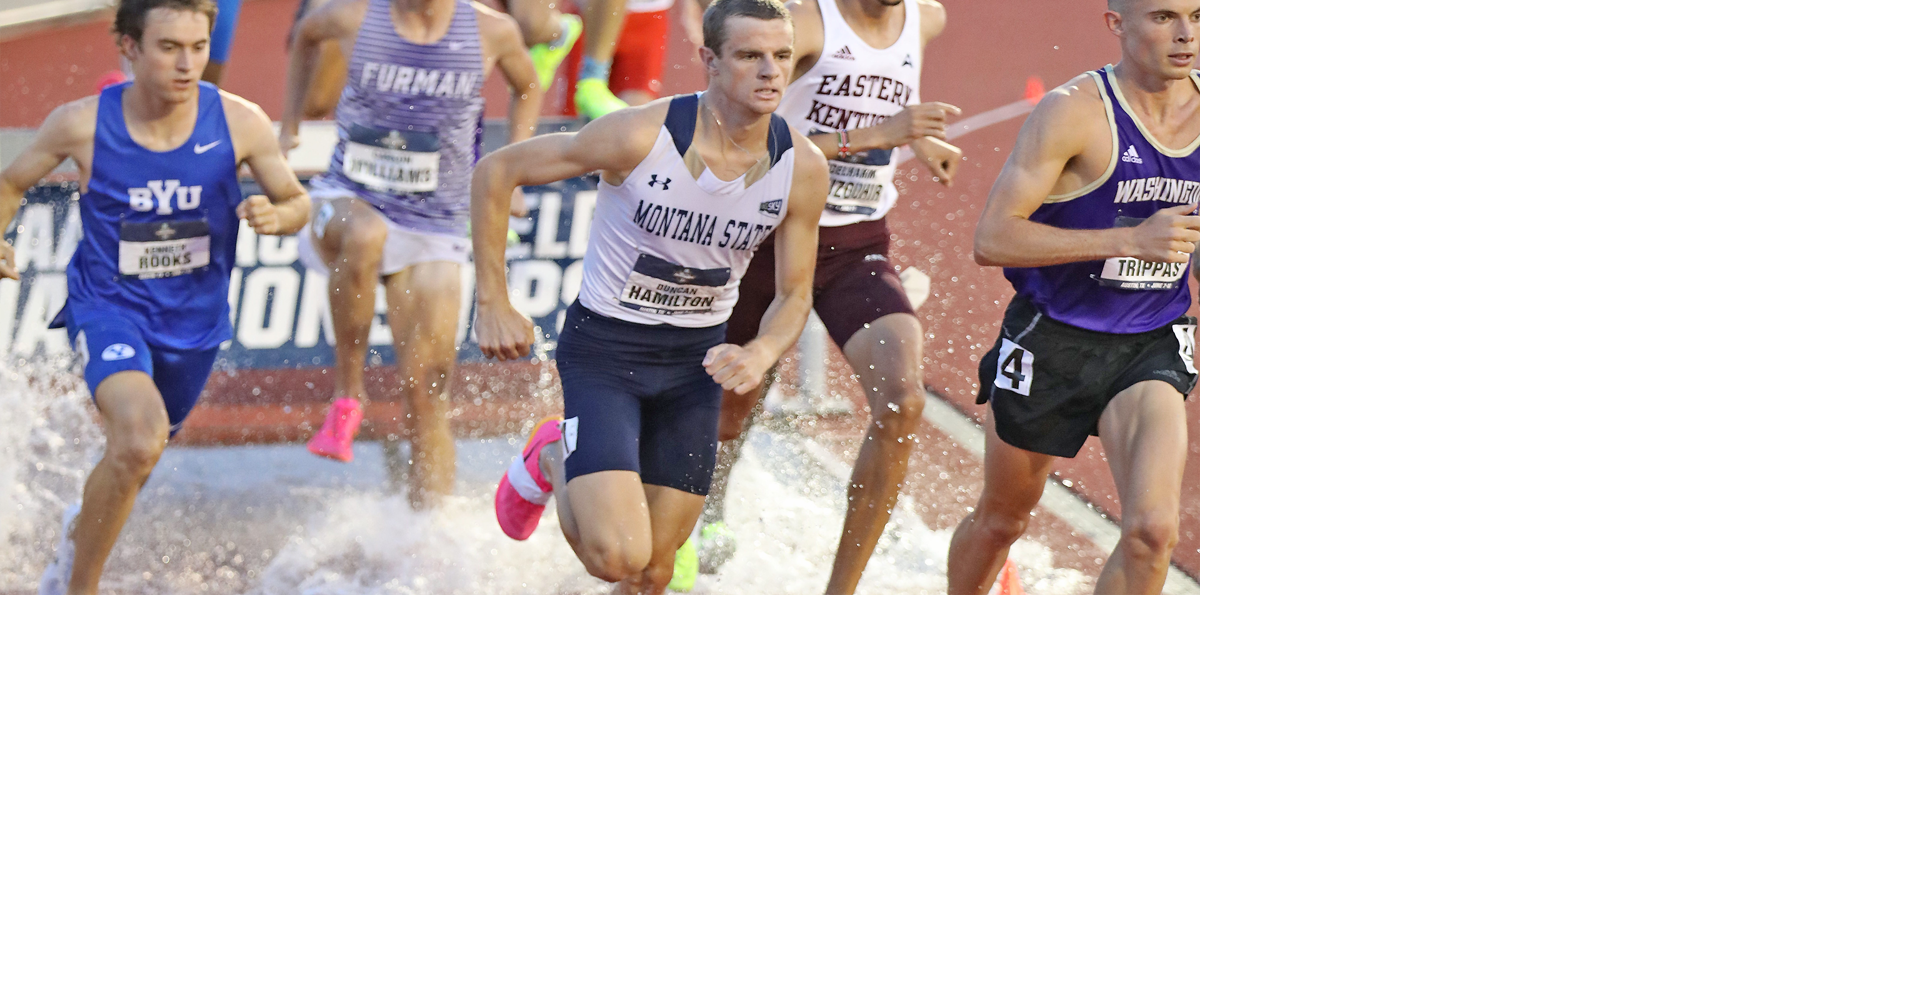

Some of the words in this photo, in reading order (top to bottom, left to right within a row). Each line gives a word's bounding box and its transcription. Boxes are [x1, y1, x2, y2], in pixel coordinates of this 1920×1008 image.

[360, 61, 478, 99] FURMAN
[816, 74, 912, 107] EASTERN
[127, 179, 203, 215] BYU
[633, 199, 718, 247] MONTANA
[139, 252, 192, 269] ROOKS
[1118, 259, 1181, 278] TRIPPAS
[629, 285, 714, 307] HAMILTON
[656, 283, 698, 295] DUNCAN
[1001, 348, 1025, 389] 4
